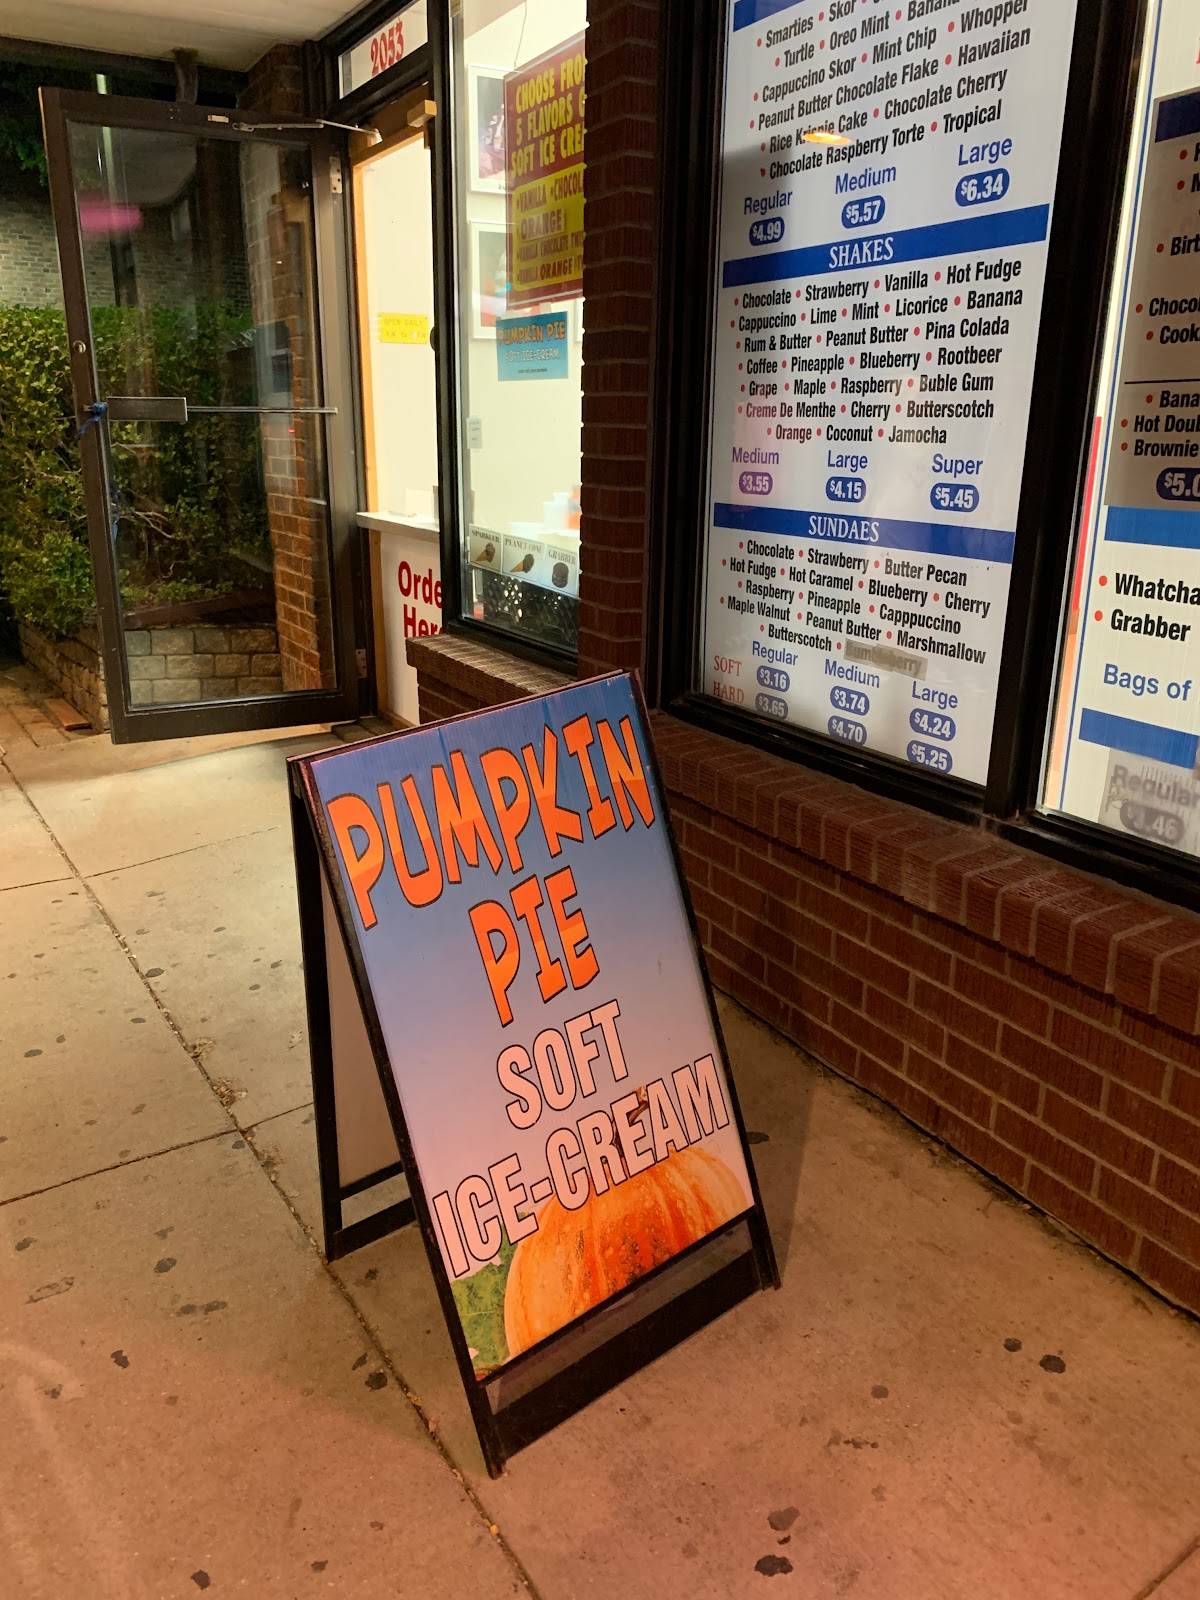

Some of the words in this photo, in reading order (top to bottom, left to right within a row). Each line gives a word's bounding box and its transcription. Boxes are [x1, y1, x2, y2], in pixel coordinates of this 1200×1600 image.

[766, 14, 814, 48] Smarties
[829, 0, 855, 22] Skor
[784, 42, 814, 67] Turtle
[830, 26, 856, 50] Oreo
[861, 12, 889, 39] Mint
[908, 0, 960, 22] Bana
[371, 21, 404, 76] 2053
[762, 69, 824, 103] Cappuccino
[829, 56, 856, 79] Skor
[872, 39, 902, 64] Mint
[906, 26, 936, 52] Chip
[961, 0, 1028, 33] Whopper
[516, 68, 554, 113] CHOOSE
[758, 109, 794, 130] Peanut
[798, 94, 832, 118] Butter
[836, 72, 897, 104] Chocolate
[902, 59, 938, 85] Flake
[958, 27, 1030, 66] Hawaiian
[516, 117, 523, 144] 5
[528, 93, 573, 139] FLAVORS
[770, 133, 792, 153] Rice
[839, 110, 868, 134] Cake
[884, 85, 951, 120] Chocolate
[957, 69, 1007, 98] Cherry
[512, 150, 533, 178] SOFT
[540, 138, 554, 166] ICE
[770, 152, 822, 179] Chocolate
[826, 136, 888, 166] Raspberry
[892, 123, 924, 147] Torte
[943, 99, 1001, 134] Tropical
[744, 191, 792, 215] Regular
[836, 166, 896, 194] Medium
[958, 137, 1012, 166] Large
[521, 209, 562, 240] ORANGE
[753, 221, 781, 241] $4.99
[846, 200, 880, 224] $5.57
[961, 174, 1003, 201] $6.34
[540, 259, 572, 280] ORANGE
[829, 238, 894, 268] SHAKES
[743, 290, 791, 308] Chocolate
[805, 280, 869, 302] Strawberry
[884, 271, 928, 292] Vanilla
[947, 264, 971, 285] Hot
[975, 259, 1021, 282] Fudge
[546, 320, 565, 340] PIE
[739, 313, 796, 333] Cappuccino
[811, 308, 837, 324] Lime
[852, 302, 879, 321] Mint
[896, 296, 948, 316] Licorice
[967, 290, 1022, 309] Banana
[745, 338, 766, 352] Rum
[769, 336, 776, 350] &
[780, 333, 811, 349] Butter
[826, 331, 866, 346] Peanut
[870, 326, 908, 344] Butter
[926, 322, 954, 340] Pina
[960, 317, 1009, 336] Colada
[747, 359, 777, 374] Coffee
[791, 356, 844, 373] Pineapple
[860, 351, 920, 371] Blueberry
[938, 347, 1002, 366] Rootbeer
[749, 382, 777, 399] Grape
[794, 380, 826, 398] Maple
[841, 378, 902, 396] Raspberry
[919, 375, 957, 392] Buble
[962, 373, 993, 391] Gum
[746, 402, 776, 418] Creme
[780, 403, 793, 417] De
[796, 402, 836, 417] Menthe
[851, 402, 890, 421] Cherry
[907, 400, 994, 418] Butterscotch
[1134, 415, 1160, 432] Hot
[776, 425, 812, 443] Orange
[826, 425, 872, 441] Coconut
[888, 426, 947, 444] Jamocha
[1134, 439, 1199, 457] Brownie
[732, 447, 779, 465] Medium
[828, 450, 868, 472] Large
[932, 454, 983, 478] Super
[742, 474, 769, 492] $3.55
[830, 480, 862, 499] $4.15
[935, 486, 974, 509] $5.45
[808, 515, 880, 542] SUNDAES
[747, 540, 795, 560] Chocolate
[808, 548, 869, 574] Strawberry
[885, 559, 923, 579] Butter
[927, 564, 967, 586] Pecan
[730, 557, 745, 572] Hot
[748, 560, 776, 579] Fudge
[789, 567, 806, 583] Hot
[810, 570, 853, 591] Caramel
[869, 579, 928, 607] Blueberry
[945, 591, 990, 618] Cherry
[746, 581, 794, 604] Raspberry
[808, 591, 860, 615] Pineapple
[880, 604, 961, 635] Capppuccino
[1115, 573, 1200, 605] Whatcha
[727, 596, 754, 614] Maple
[757, 601, 790, 622] Walnut
[806, 612, 843, 633] Peanut
[846, 621, 882, 641] Butter
[897, 631, 986, 665] Marshmallow
[768, 624, 832, 652] Butterscotch
[1111, 610, 1191, 642] Grabber
[714, 655, 742, 677] SOFT
[759, 670, 786, 689] $3.16
[833, 690, 865, 713] $3.74
[914, 712, 951, 737] $4.24
[752, 641, 798, 667] Regular
[825, 659, 880, 688] Medium
[912, 681, 958, 709] Large
[1104, 664, 1158, 695] Bags
[1167, 679, 1191, 700] of
[713, 681, 744, 703] HARD
[759, 698, 784, 717] $3.65
[831, 719, 863, 743] $4.70
[912, 744, 948, 771] $5.25
[325, 713, 657, 931] PUMPKIN
[469, 865, 600, 1027] PIE
[496, 999, 630, 1130] SOFT
[431, 1053, 730, 1278] ICE-CREAM
